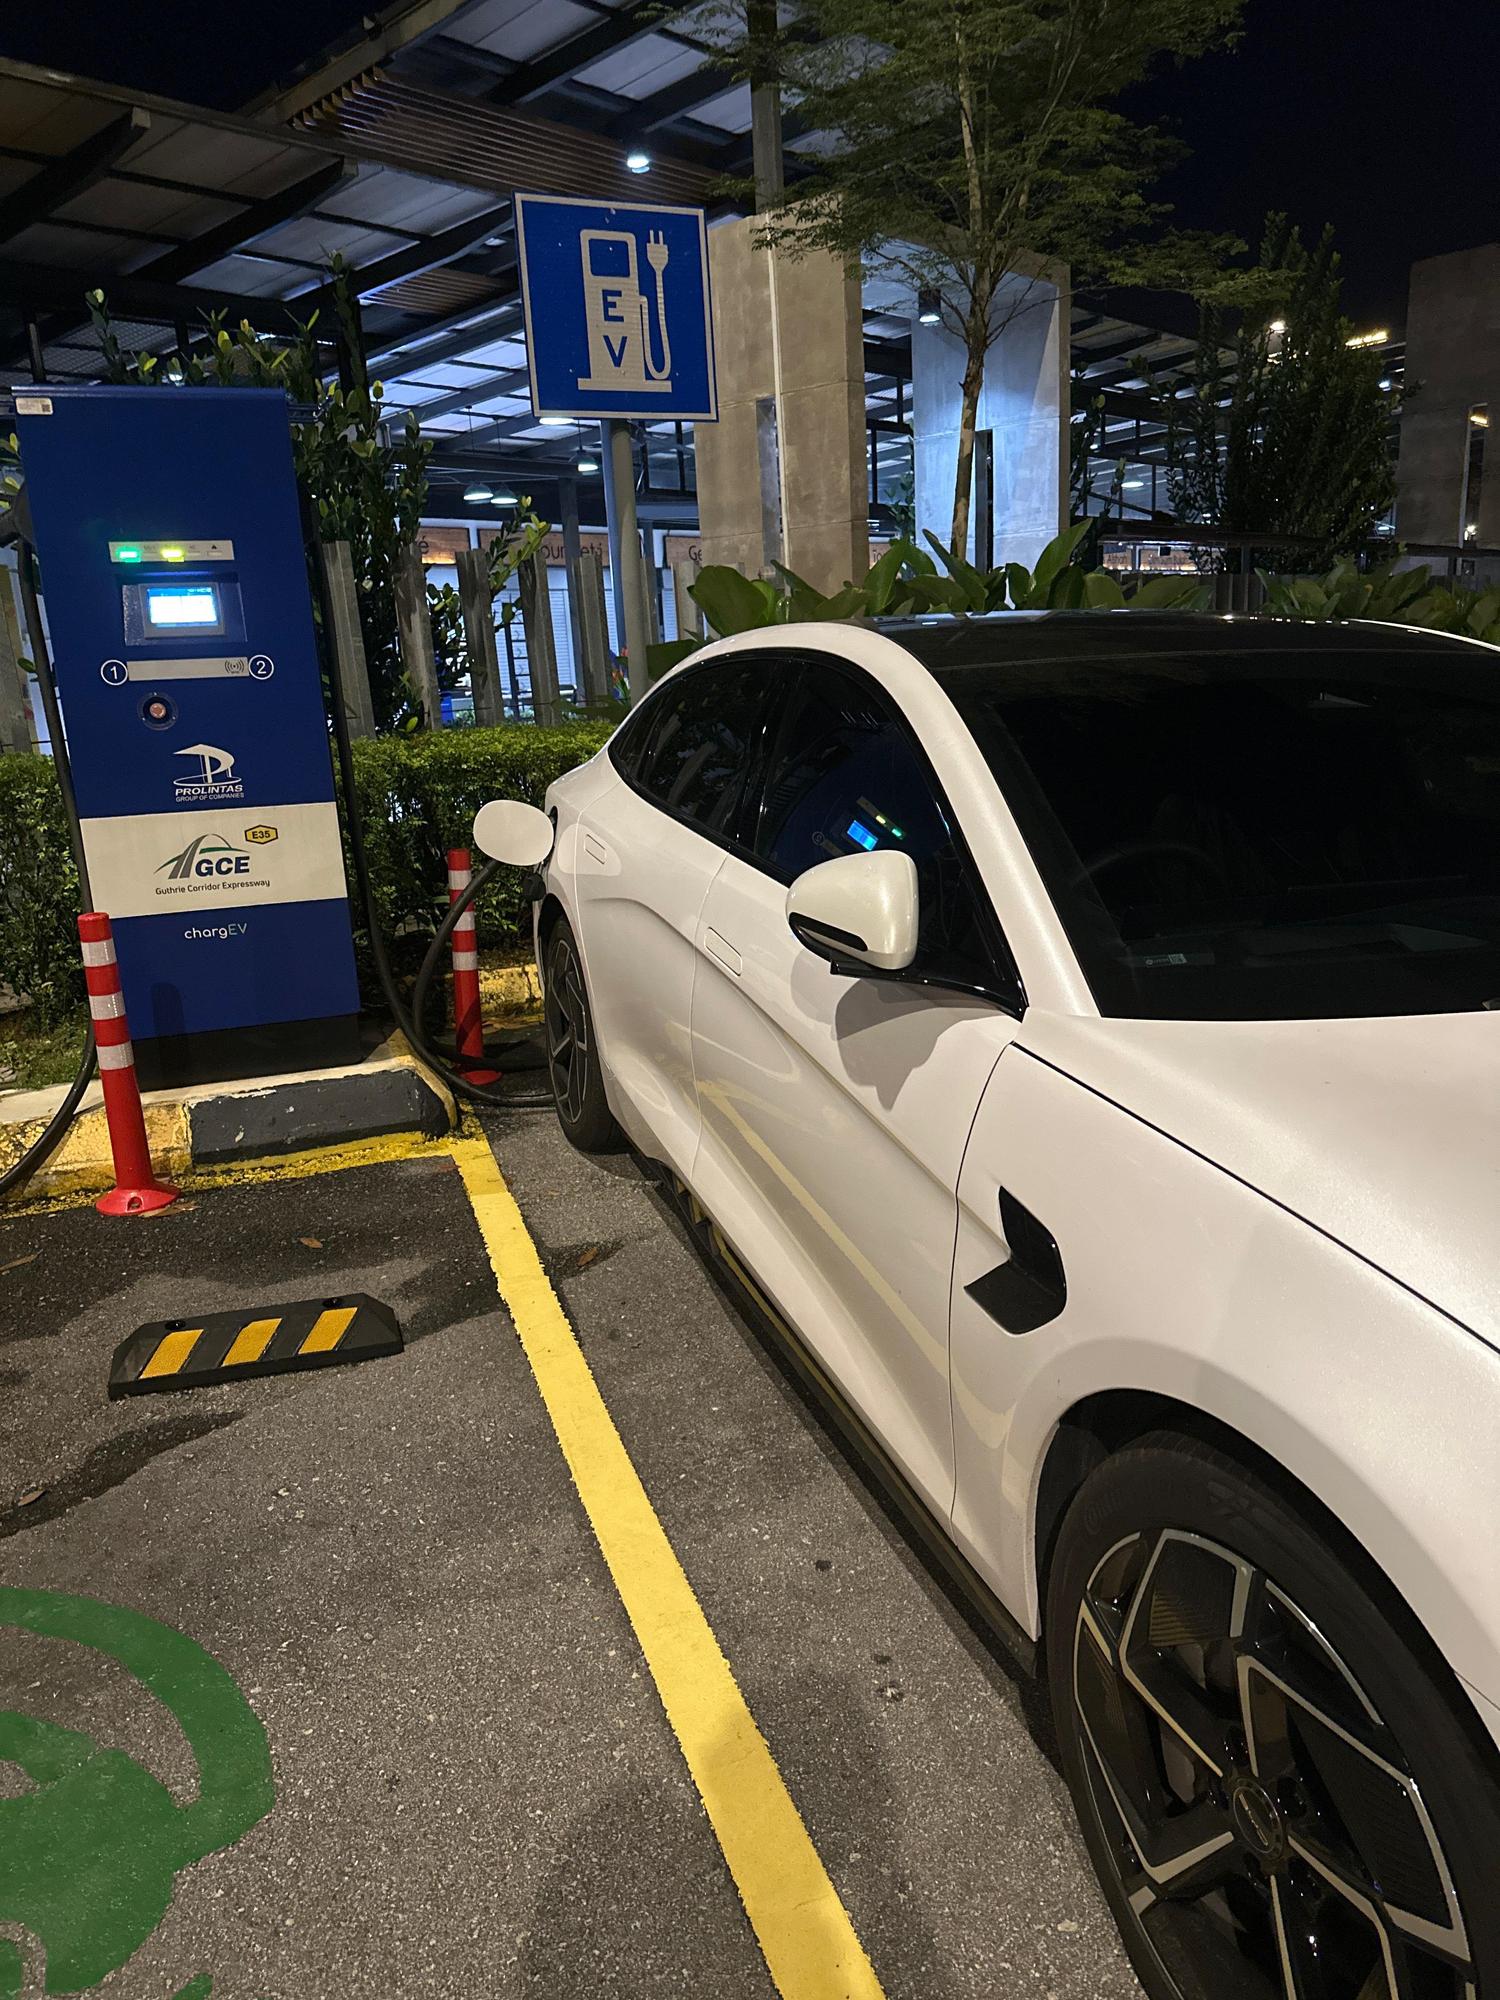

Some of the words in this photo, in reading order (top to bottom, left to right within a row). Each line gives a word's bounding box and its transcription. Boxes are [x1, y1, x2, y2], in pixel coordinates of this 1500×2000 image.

[110, 665, 118, 680] 1
[255, 660, 267, 675] 2
[175, 784, 244, 796] PROLINTAS
[175, 795, 199, 803] GROUP
[208, 792, 245, 800] COMPANIES
[251, 830, 271, 839] E35
[195, 855, 250, 877] GCE
[155, 886, 186, 896] Guthrie
[187, 883, 220, 893] Corridor
[222, 880, 271, 890] Expressway
[184, 922, 248, 939] chargEV
